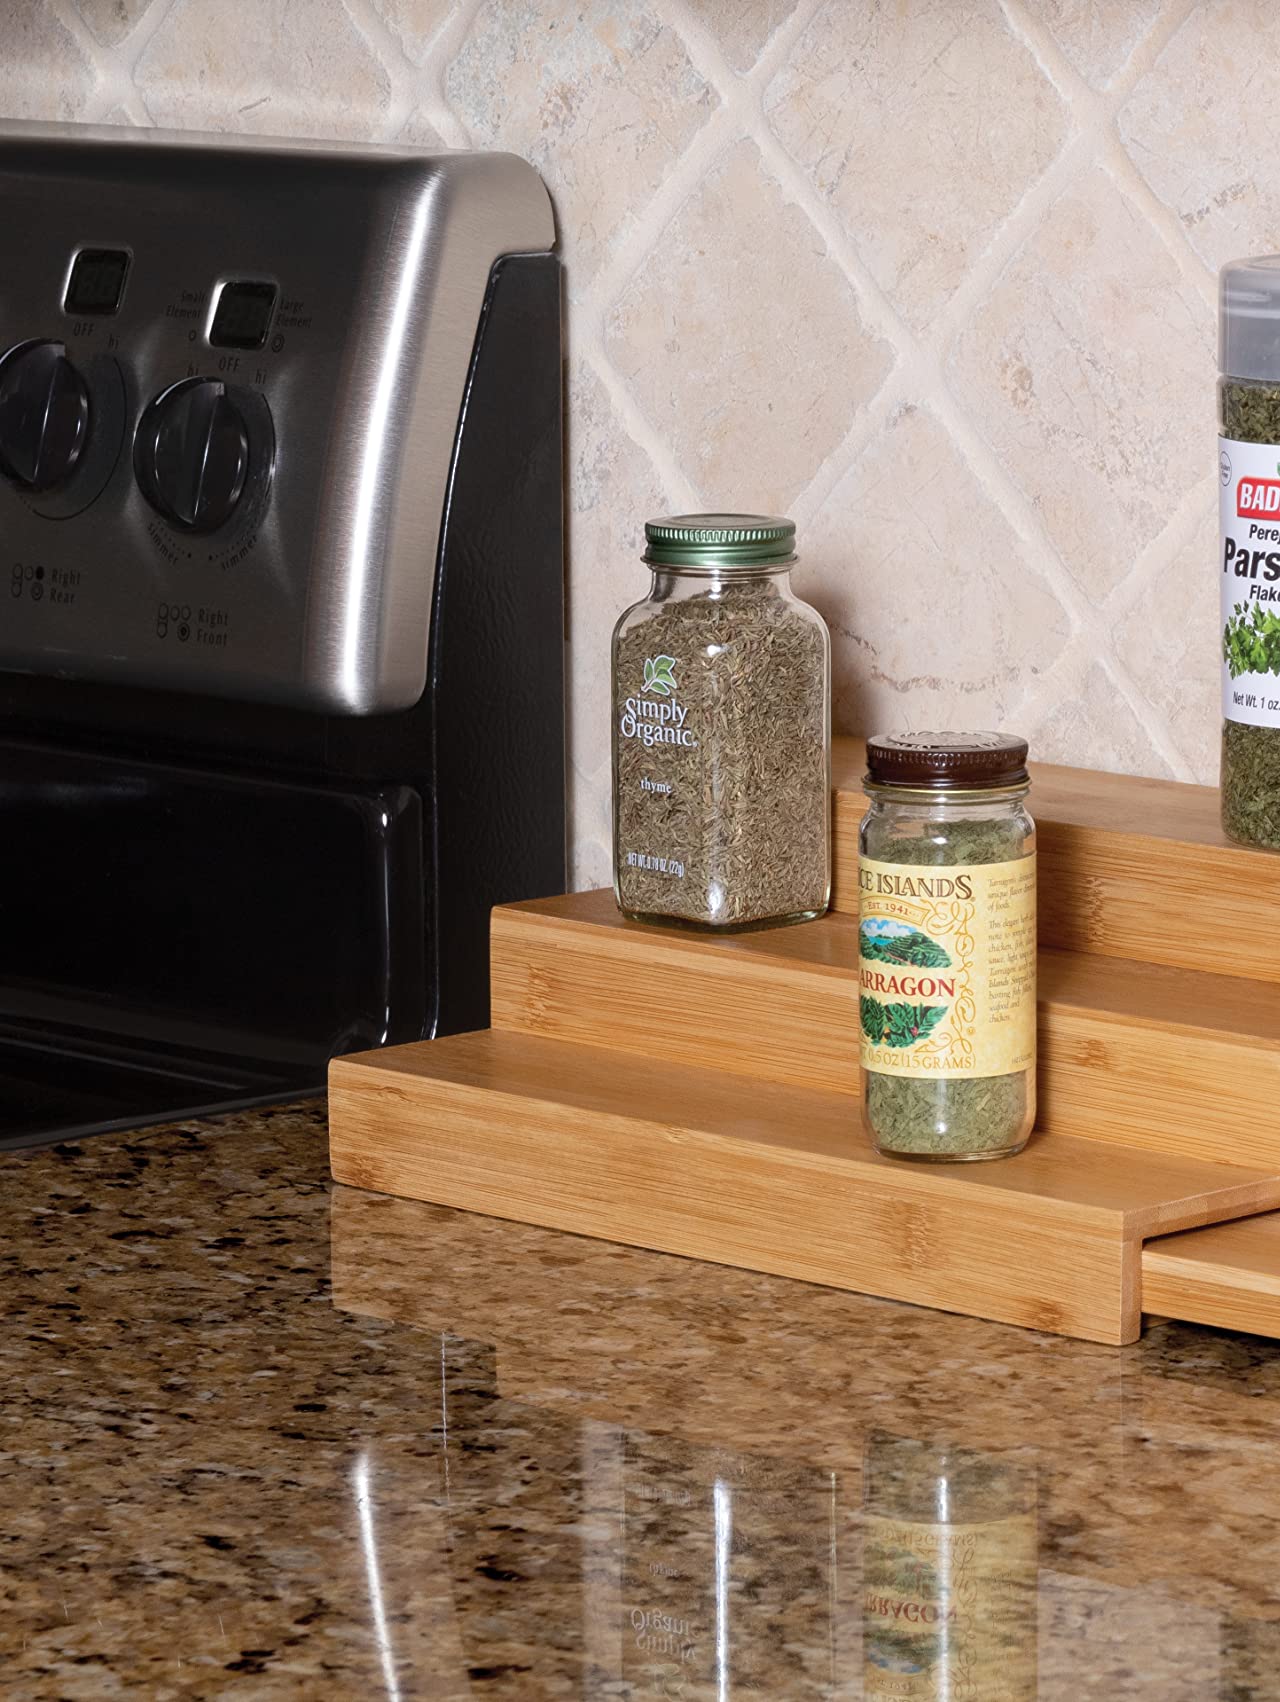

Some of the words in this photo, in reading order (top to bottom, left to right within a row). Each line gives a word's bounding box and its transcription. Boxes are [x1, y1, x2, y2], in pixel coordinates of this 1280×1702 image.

[166, 305, 201, 319] Element
[280, 300, 303, 313] Large
[73, 323, 94, 336] OFF
[277, 314, 312, 328] Element
[109, 337, 119, 349] hi
[219, 357, 241, 371] OFF
[255, 369, 266, 384] hi
[147, 522, 178, 566] simmer
[221, 534, 258, 570] simmer
[51, 569, 81, 586] Right
[50, 589, 75, 604] Rear
[198, 609, 228, 628] Right
[197, 629, 228, 646] Front
[1233, 691, 1244, 706] Net
[1260, 697, 1265, 708] 1
[1267, 700, 1280, 711] oz.
[625, 693, 688, 727] Simply
[621, 714, 693, 746] Organic
[641, 777, 672, 794] thyme
[877, 874, 972, 900] ISLANDS
[885, 903, 908, 915] 1941
[922, 1052, 976, 1070] GRAMS)
